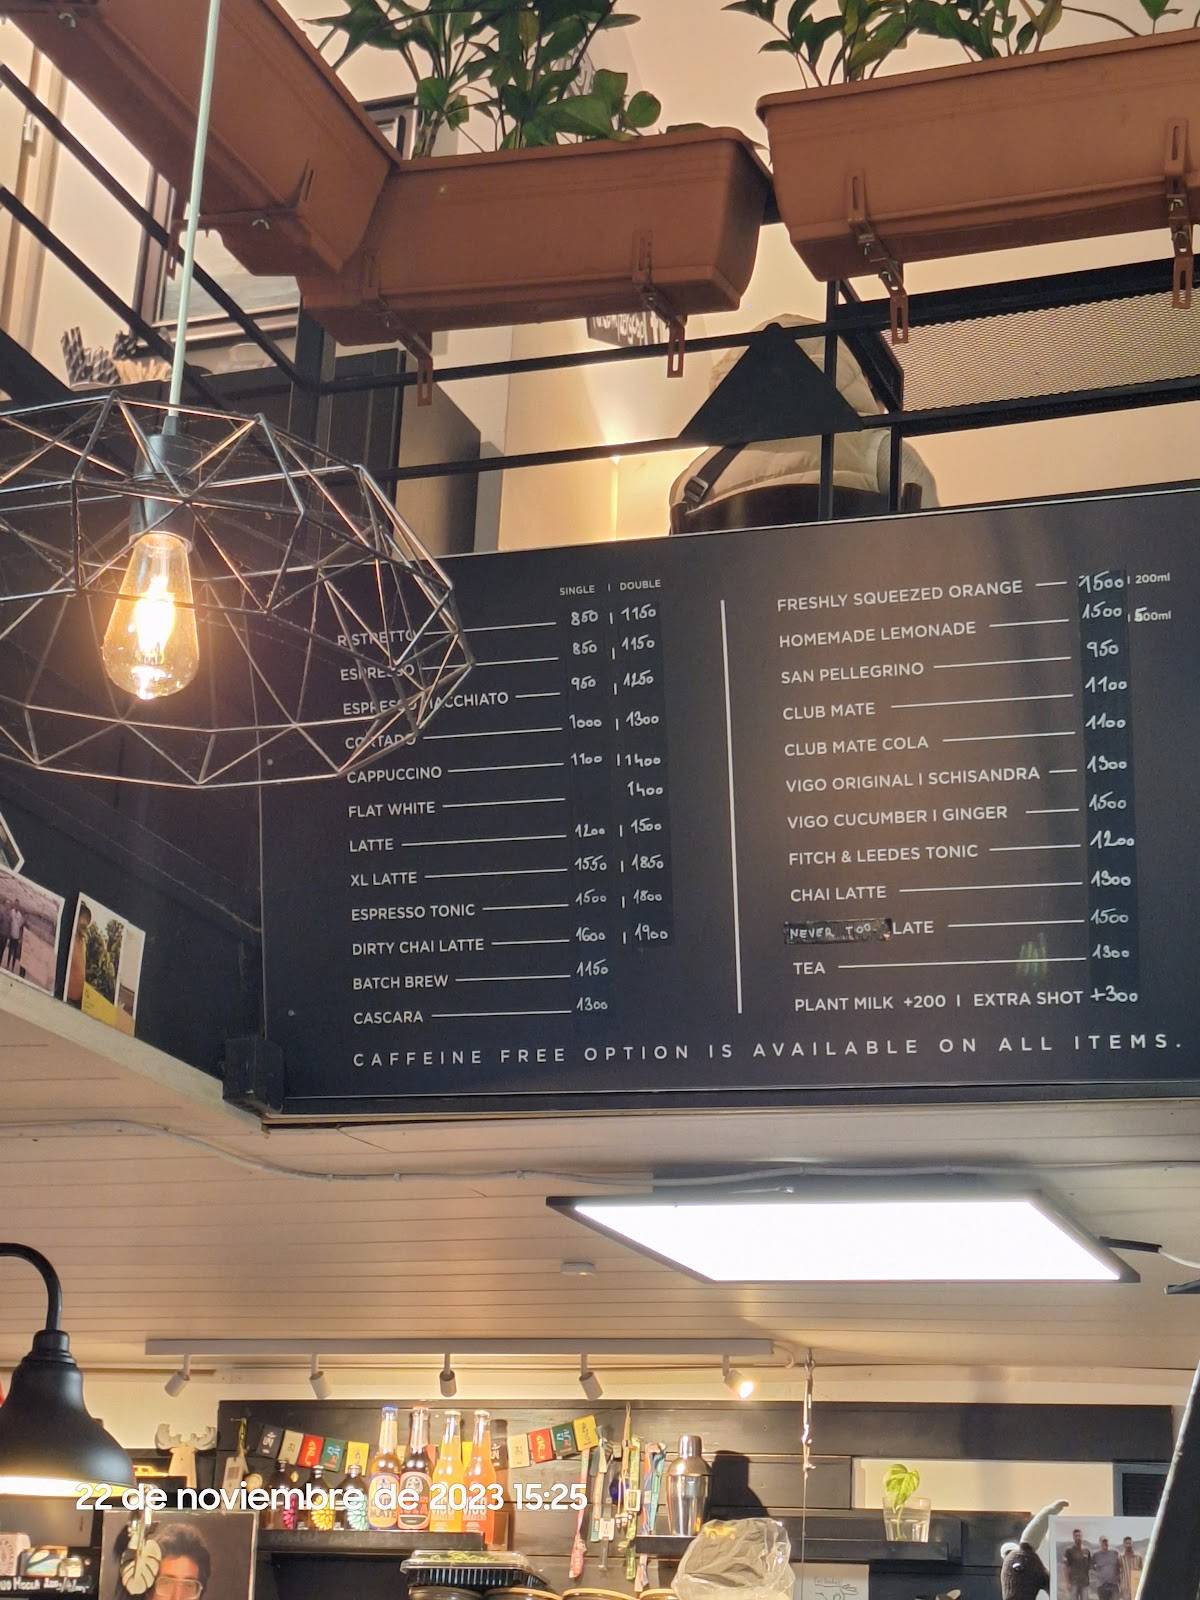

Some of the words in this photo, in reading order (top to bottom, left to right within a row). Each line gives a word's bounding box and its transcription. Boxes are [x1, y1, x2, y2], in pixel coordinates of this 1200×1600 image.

[560, 585, 595, 595] SINGLE
[620, 580, 661, 590] DOUBLE
[778, 594, 847, 611] FRESHLY
[854, 587, 943, 605] SQUEEZED
[949, 580, 1022, 598] ORANGE
[1079, 571, 1123, 593] 1500
[1136, 573, 1170, 584] 200ml
[571, 610, 598, 625] 850
[621, 604, 656, 621] 1150
[780, 629, 875, 647] HOMEMADE
[881, 622, 976, 640] LEMONADE
[1082, 601, 1122, 618] 1500
[1134, 607, 1171, 622] 500ml
[573, 640, 597, 655] 850
[622, 634, 655, 650] 1150
[782, 670, 814, 683] SAN
[820, 663, 923, 681] PELLEGRINO
[1087, 639, 1118, 657] 950
[571, 676, 596, 690] 950
[624, 670, 653, 687] 1250
[783, 706, 825, 720] CLUB
[831, 702, 875, 717] MATE
[1085, 676, 1127, 692] 1100
[569, 715, 602, 728] 1000
[626, 711, 659, 726] 1300
[785, 742, 827, 756] CLUB
[833, 739, 877, 753] MATE
[883, 736, 928, 750] COLA
[1086, 713, 1126, 729] 1100
[347, 766, 442, 784] CAPPUCCINO
[571, 753, 602, 765] 1100
[625, 754, 660, 767] 1400
[786, 779, 826, 792] VIGO
[833, 774, 913, 790] ORIGINAL
[929, 767, 1040, 784] SCHISANDRA
[1087, 756, 1127, 772] 1300
[349, 805, 383, 817] FLAT
[388, 801, 435, 815] WHITE
[628, 781, 663, 796] 1400
[788, 815, 828, 828] VIGO
[834, 810, 927, 826] CUCUMBER
[943, 806, 1007, 821] GINGER
[1089, 792, 1126, 811] 1500
[350, 838, 393, 852] LATTE
[575, 824, 605, 837] 1200
[631, 818, 661, 833] 1500
[790, 851, 835, 865] FITCH
[842, 851, 851, 862] &
[857, 847, 920, 862] LEEDES
[925, 845, 978, 859] TONIC
[1090, 830, 1134, 848] 1200
[351, 874, 368, 886] XL
[373, 872, 417, 885] LATTE
[575, 855, 607, 871] 1550
[632, 854, 663, 870] 1850
[791, 888, 829, 901] CHAI
[836, 886, 886, 899] LATTE
[1091, 870, 1131, 886] 1300
[352, 906, 425, 921] ESPRESSO
[430, 904, 475, 917] TONIC
[576, 889, 606, 905] 1500
[634, 889, 662, 904] 1800
[353, 942, 394, 955] DIRTY
[400, 940, 434, 953] CHAI
[440, 939, 484, 951] LATTE
[576, 927, 605, 941] 1600
[635, 923, 668, 940] 1900
[790, 926, 835, 940] NEVER
[893, 921, 934, 934] LATE
[1091, 908, 1128, 924] 1500
[354, 977, 400, 989] BATCH
[405, 975, 448, 988] BREW
[577, 959, 608, 976] 1150
[793, 962, 825, 974] TEA
[1092, 944, 1129, 958] 1300
[354, 1011, 423, 1024] CASCARA
[577, 997, 608, 1011] 1300
[795, 998, 848, 1011] PLANT
[855, 997, 893, 1009] MILK
[904, 995, 945, 1008] +200
[974, 993, 1031, 1006] EXTRA
[1037, 991, 1083, 1004] SHOT
[1090, 985, 1138, 1002] +300
[354, 1051, 480, 1066] CAFFEINE
[501, 1048, 564, 1062] FREE
[585, 1045, 687, 1060] OPTION
[710, 1044, 731, 1058] IS
[753, 1040, 917, 1056] AVAILABLE
[940, 1039, 975, 1052] ON
[999, 1037, 1052, 1051] ALL
[1075, 1034, 1180, 1049] ITEMS.
